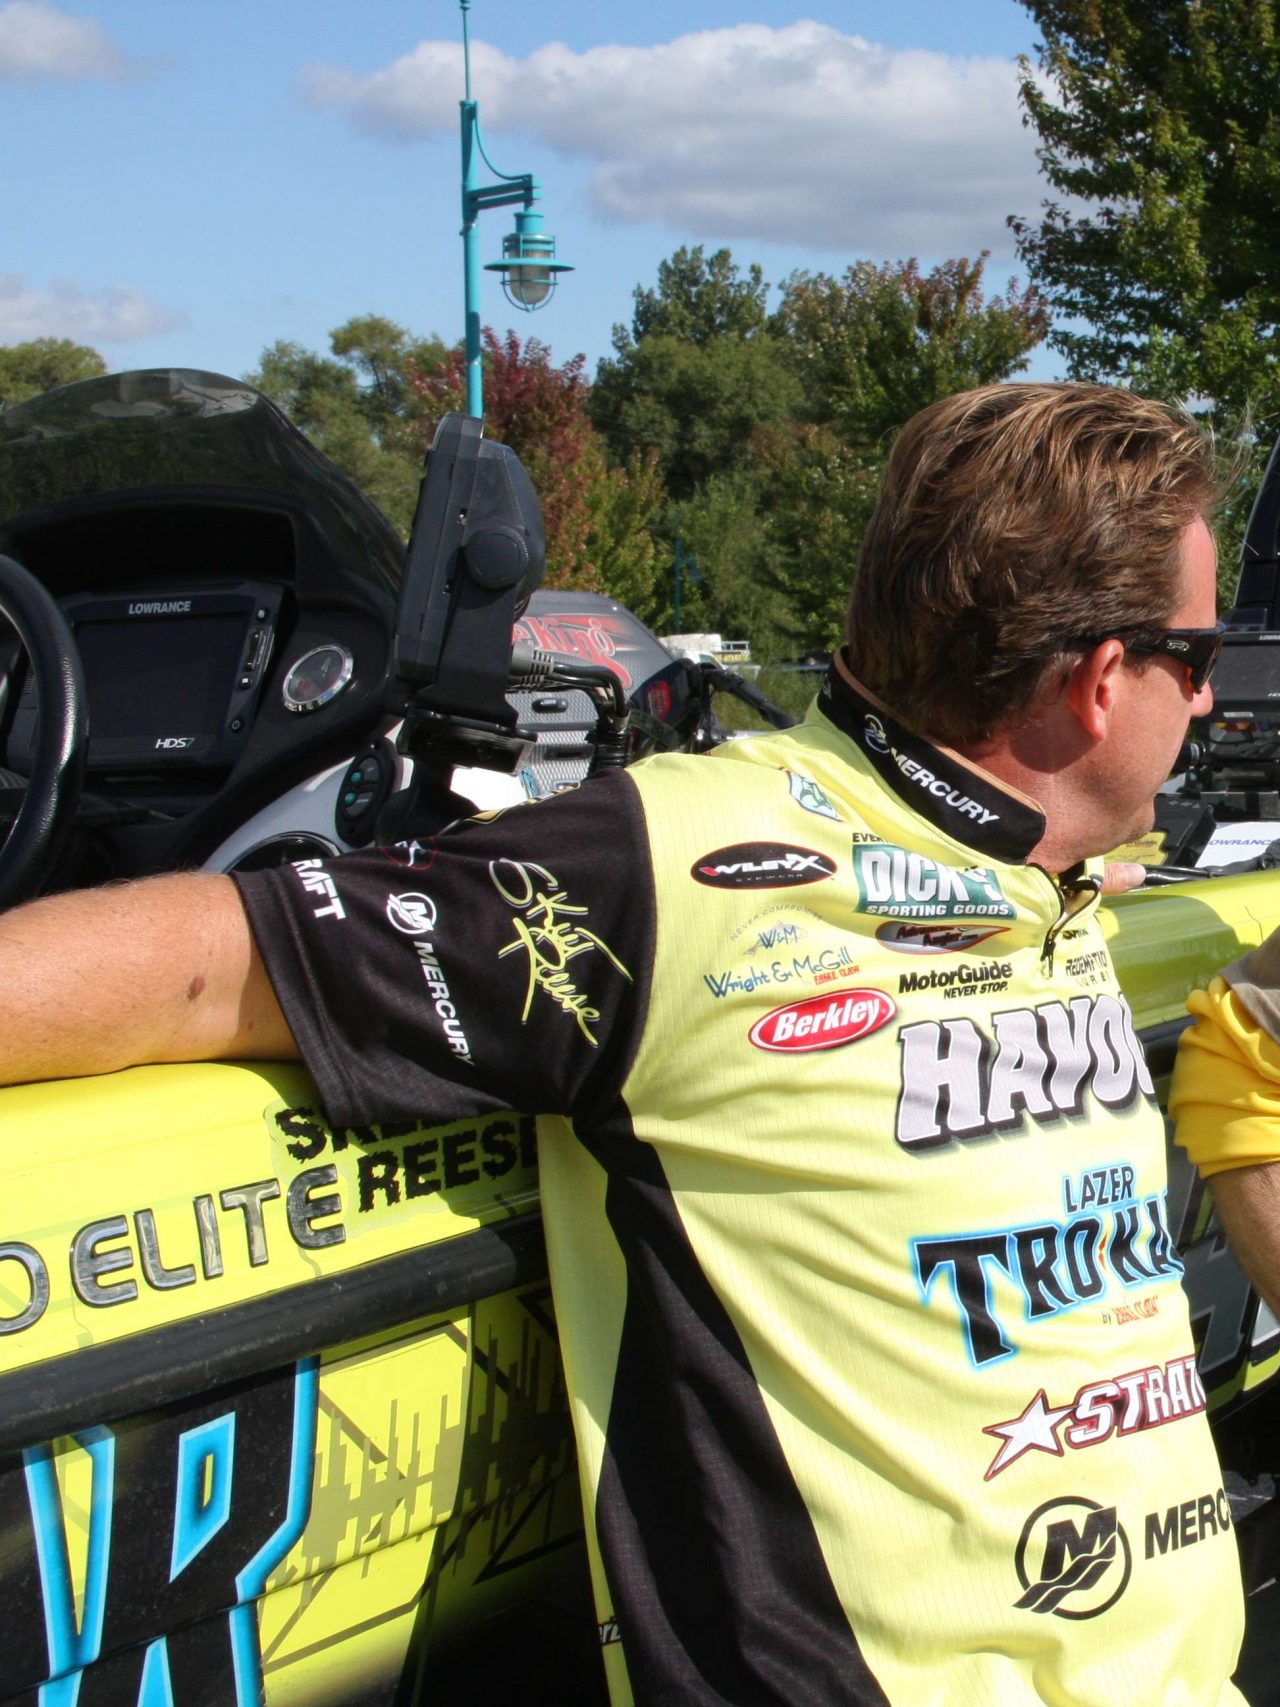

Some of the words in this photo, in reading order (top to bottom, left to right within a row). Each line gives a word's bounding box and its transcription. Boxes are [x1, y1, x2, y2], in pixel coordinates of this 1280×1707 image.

[128, 601, 192, 615] LOWRANCE
[891, 747, 999, 825] MERCURY
[1208, 838, 1273, 847] OWRANC
[730, 914, 760, 942] NEVER
[866, 903, 947, 916] SPORTING
[953, 904, 1009, 916] GOODS
[703, 966, 771, 998] Wright
[793, 947, 853, 977] McGill
[899, 961, 1012, 993] MotorGuide
[1065, 950, 1107, 976] REDEMPTIO
[413, 940, 475, 1066] MERCURY
[943, 985, 977, 1000] NEVER
[773, 998, 880, 1043] Berkley
[1065, 1166, 1135, 1213] LAZER
[70, 1164, 347, 1309] ELITE
[913, 1198, 1185, 1366] TROKA
[1066, 1357, 1207, 1446] STRAT
[1145, 1486, 1232, 1560] MERC
